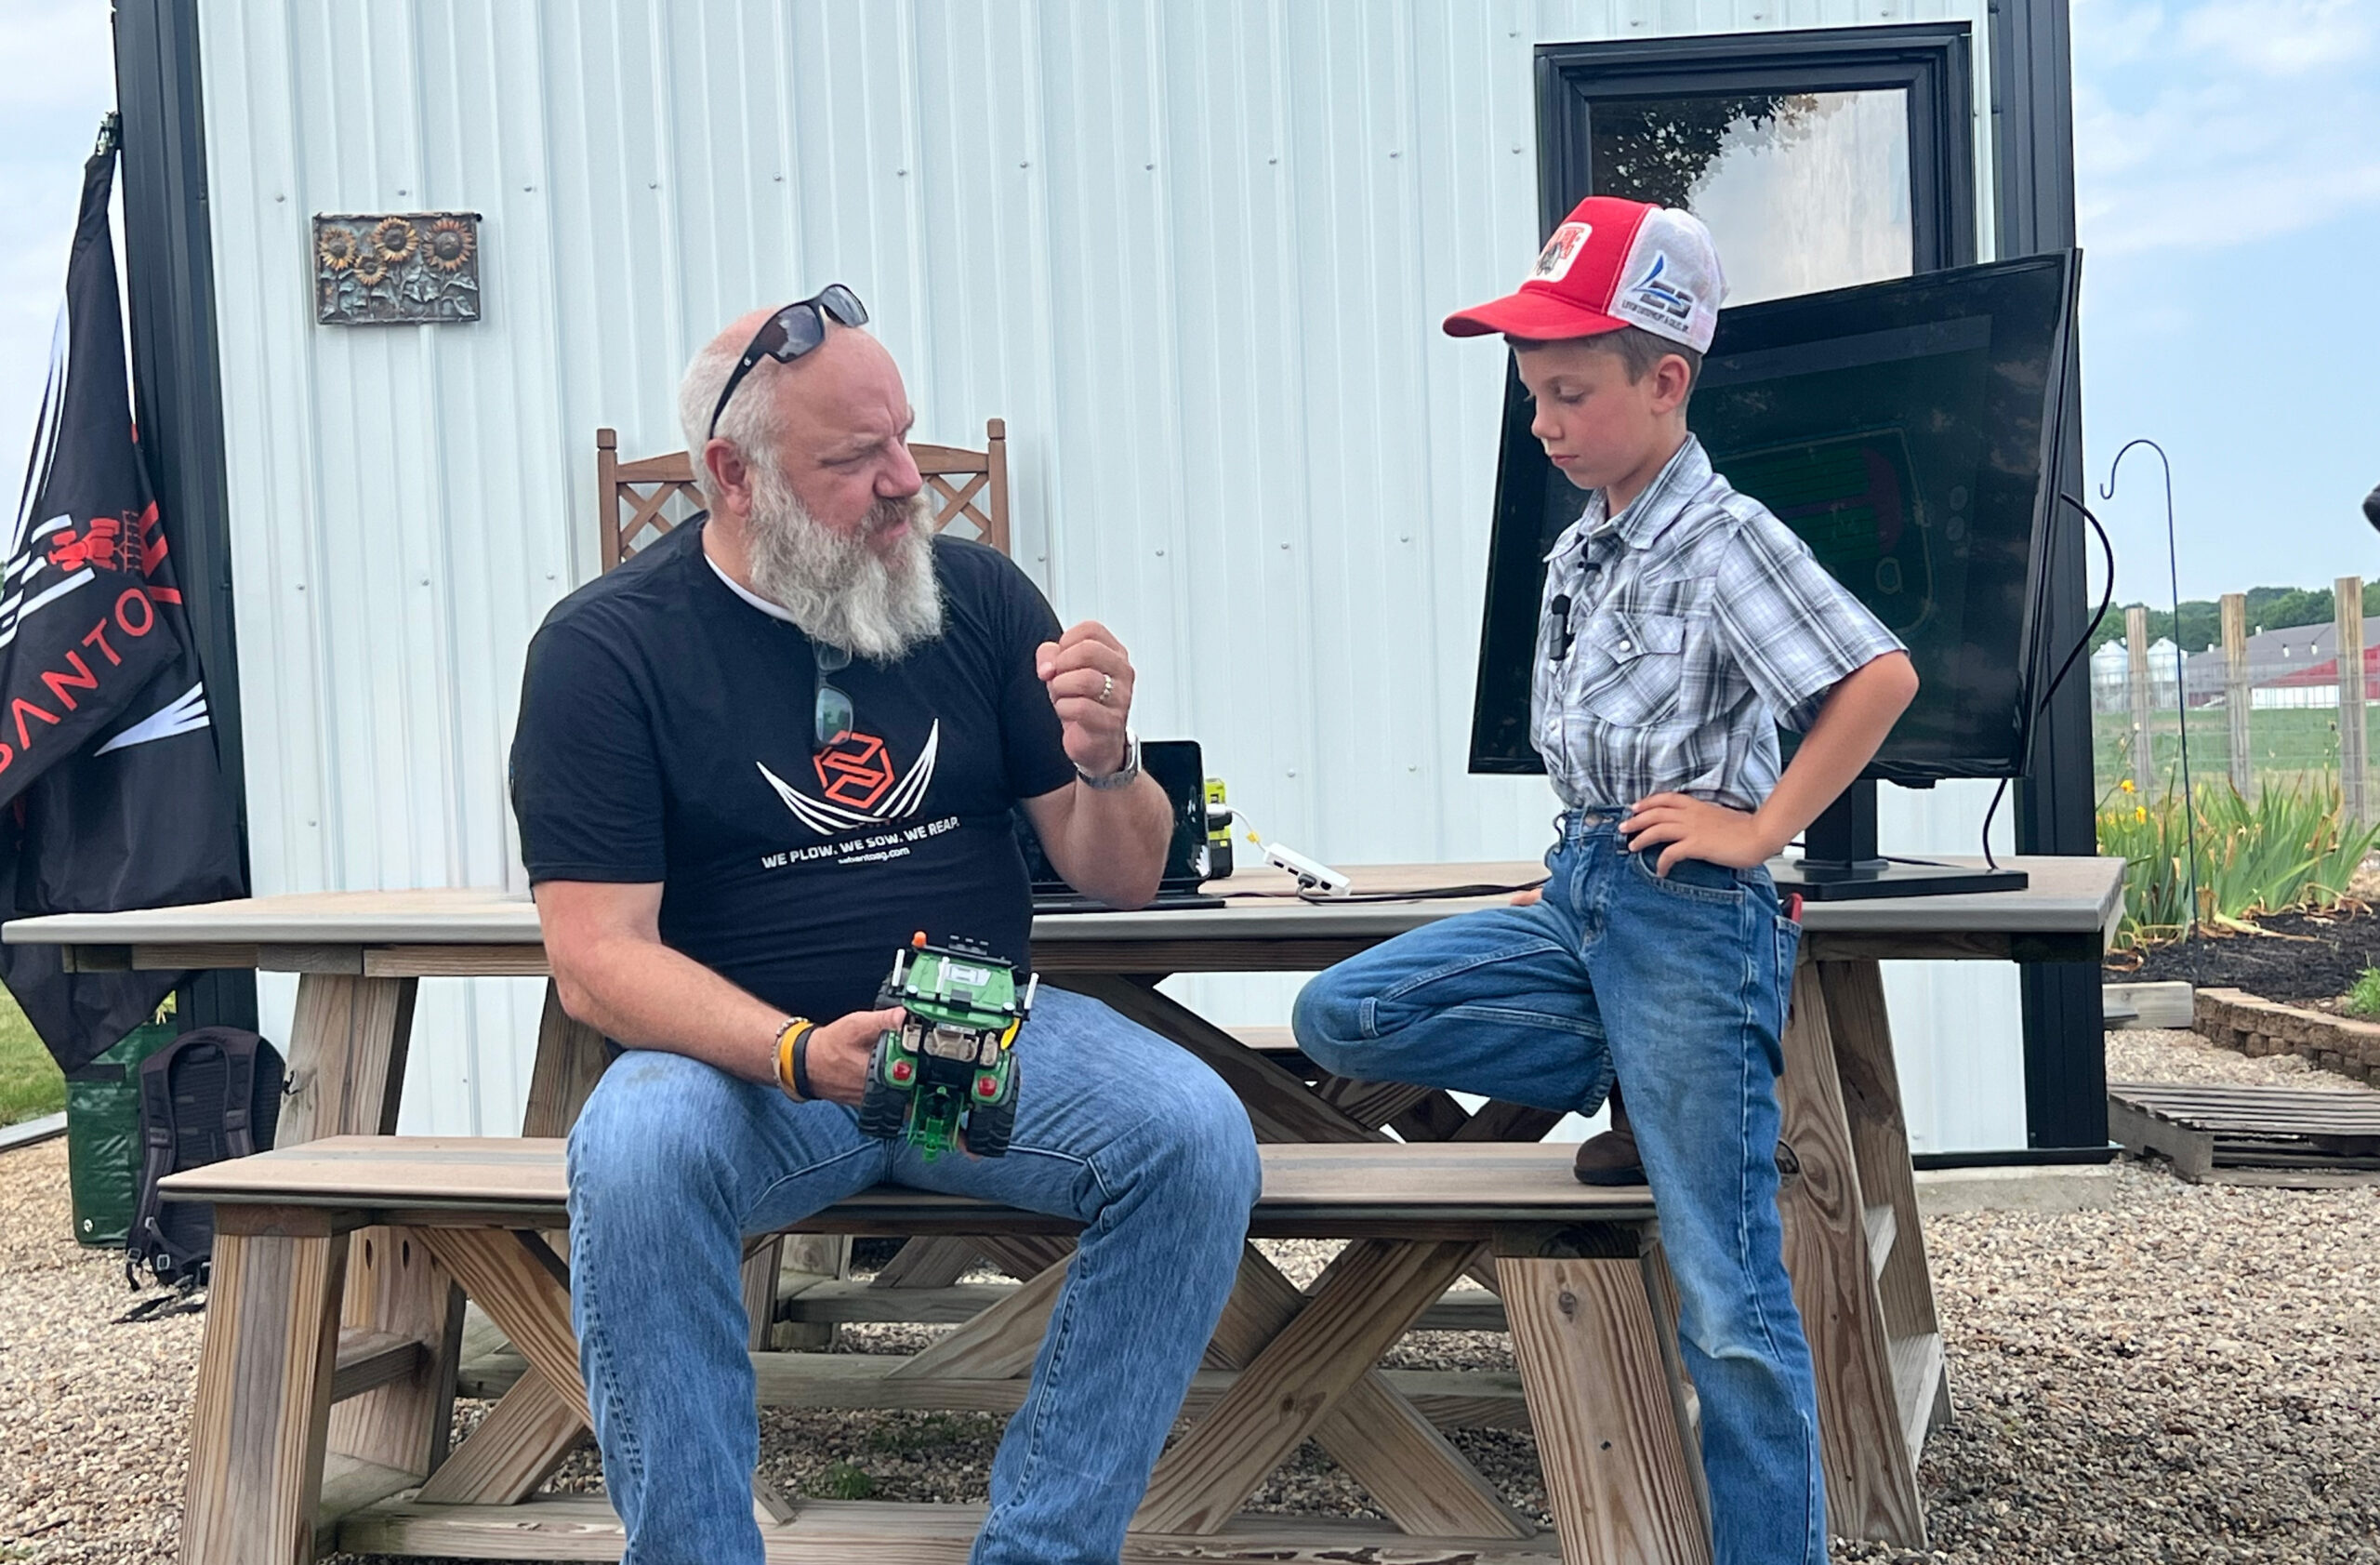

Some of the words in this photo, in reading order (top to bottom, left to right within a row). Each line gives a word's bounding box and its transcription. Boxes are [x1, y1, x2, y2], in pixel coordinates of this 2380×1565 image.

[761, 852, 787, 869] WE
[789, 844, 839, 863] PLOW.
[839, 839, 865, 854] WE
[866, 833, 904, 848] SOW.
[903, 826, 928, 842] WE
[928, 816, 960, 836] REAP.
